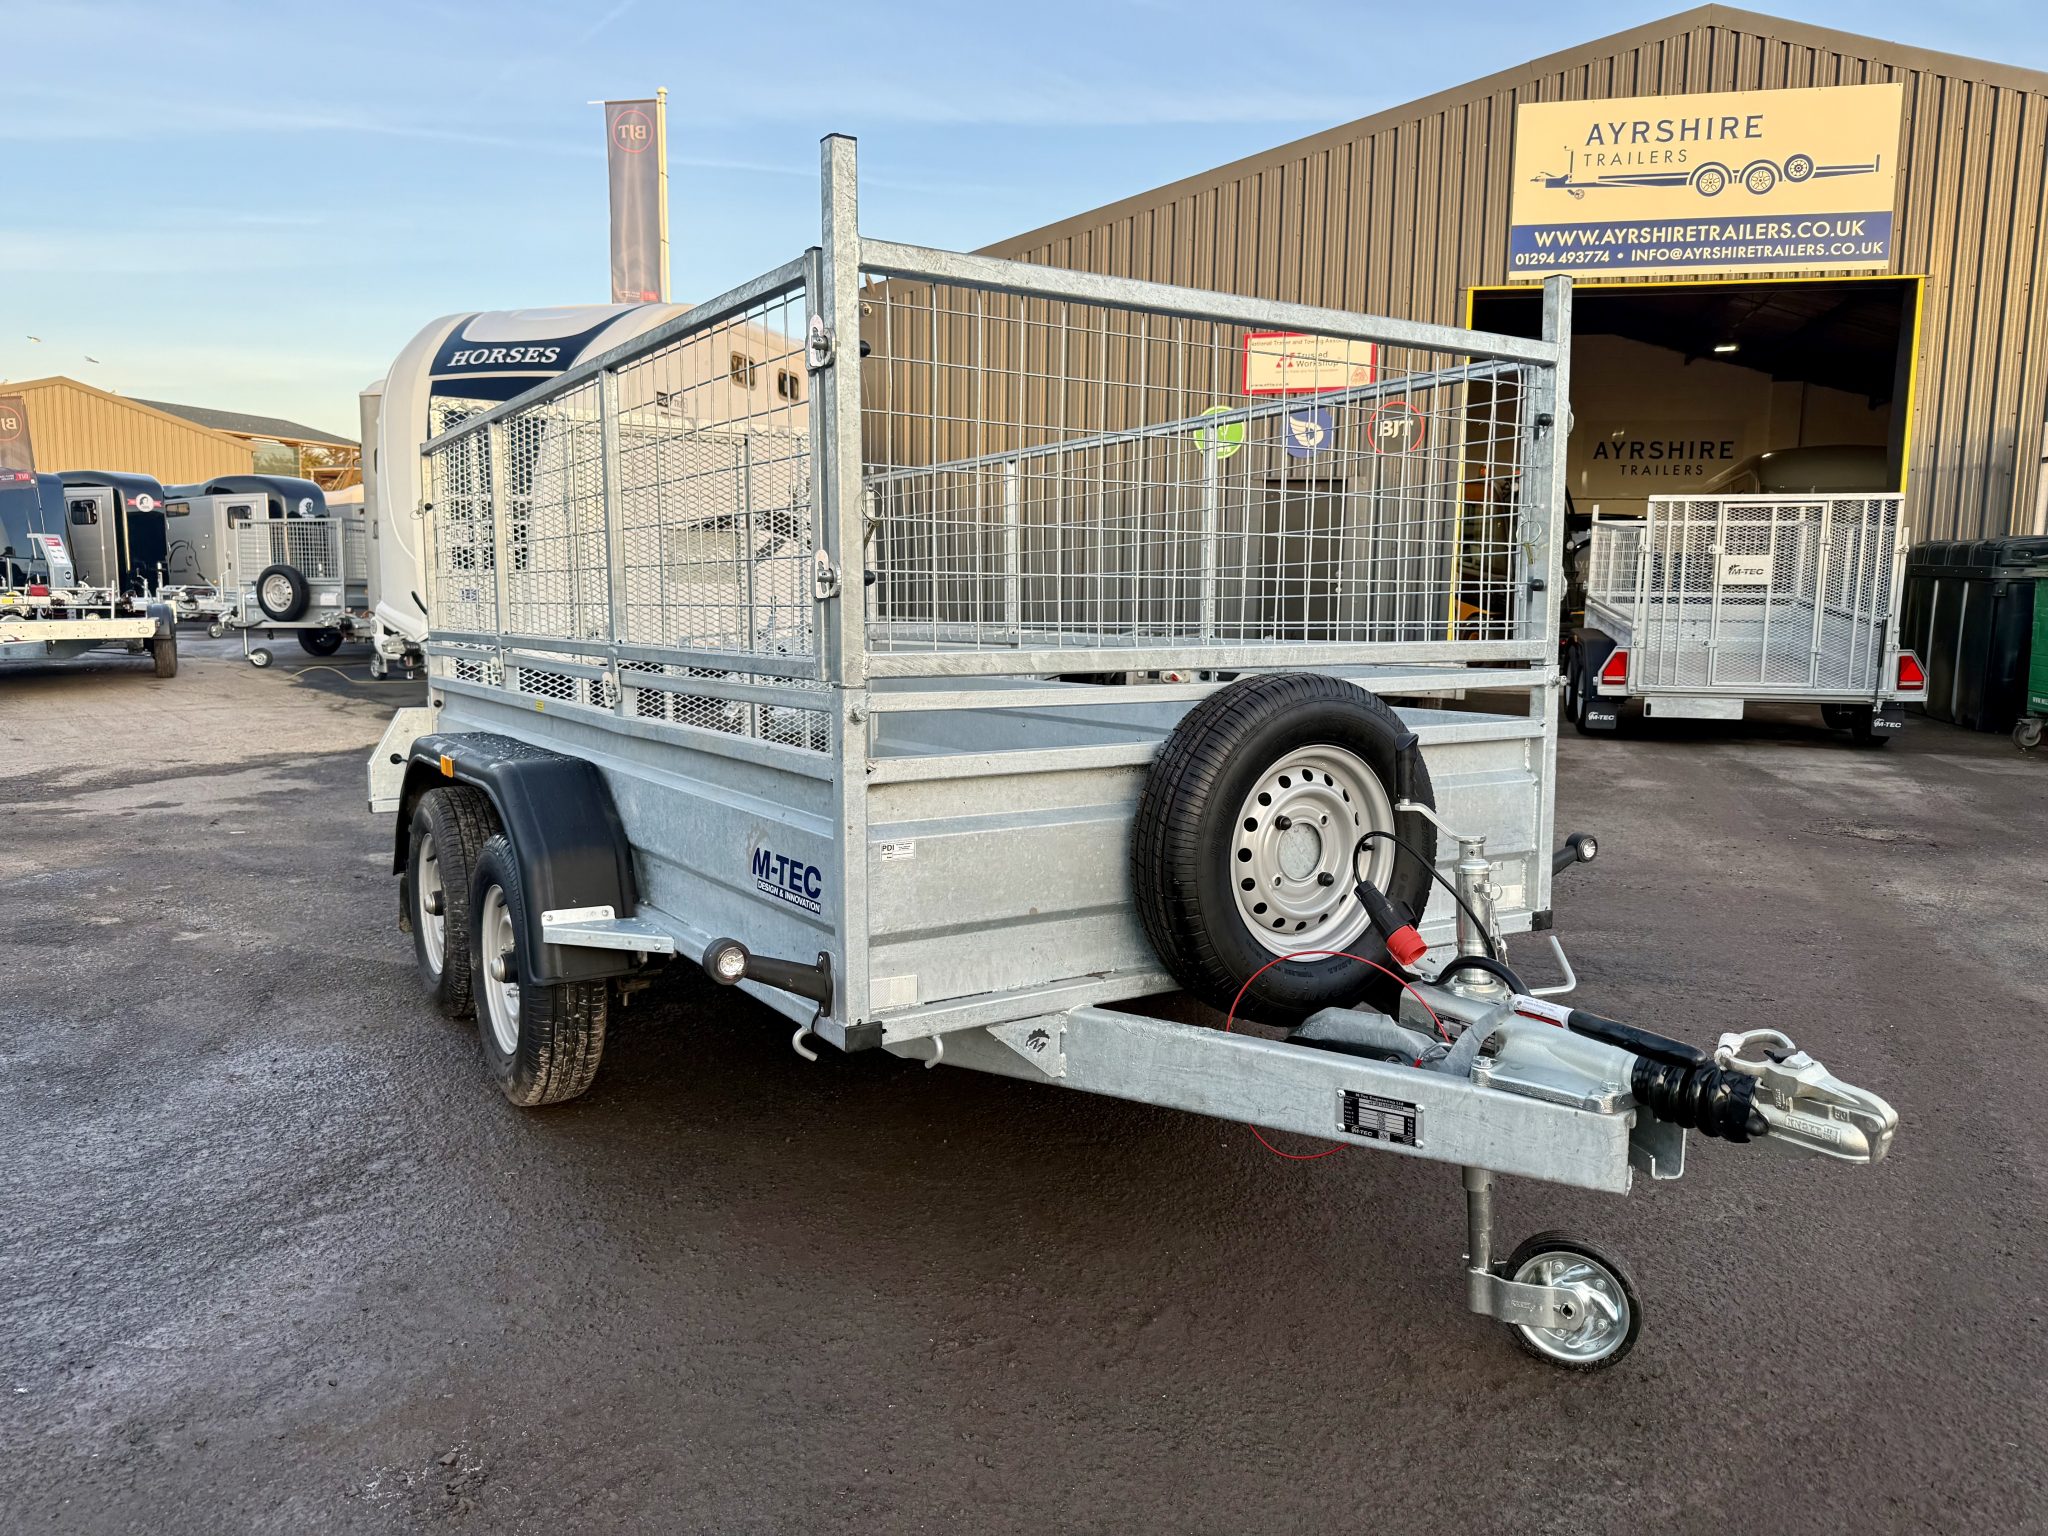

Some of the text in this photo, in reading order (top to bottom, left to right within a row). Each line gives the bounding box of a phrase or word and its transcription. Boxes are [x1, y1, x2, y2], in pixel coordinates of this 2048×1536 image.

[1585, 114, 1764, 146] AYRSHIRE
[1584, 149, 1688, 167] TRAILERS
[1534, 220, 1865, 248] WWW.AYRSHIRETRAILERS.CO.UK
[1515, 241, 1883, 266] 01294 493774 INFO@AYRSHIRETRAILERS.CO.UK
[446, 347, 560, 367] HORSES
[1296, 351, 1328, 359] Trused
[1379, 420, 1413, 438] BJT
[1593, 440, 1735, 460] AYRSHIRE
[1620, 464, 1704, 475] TRAILERS
[1730, 567, 1764, 575] M-TEC
[752, 847, 822, 899] M-TEC
[757, 880, 820, 913] DESIGN & INNOVATION
